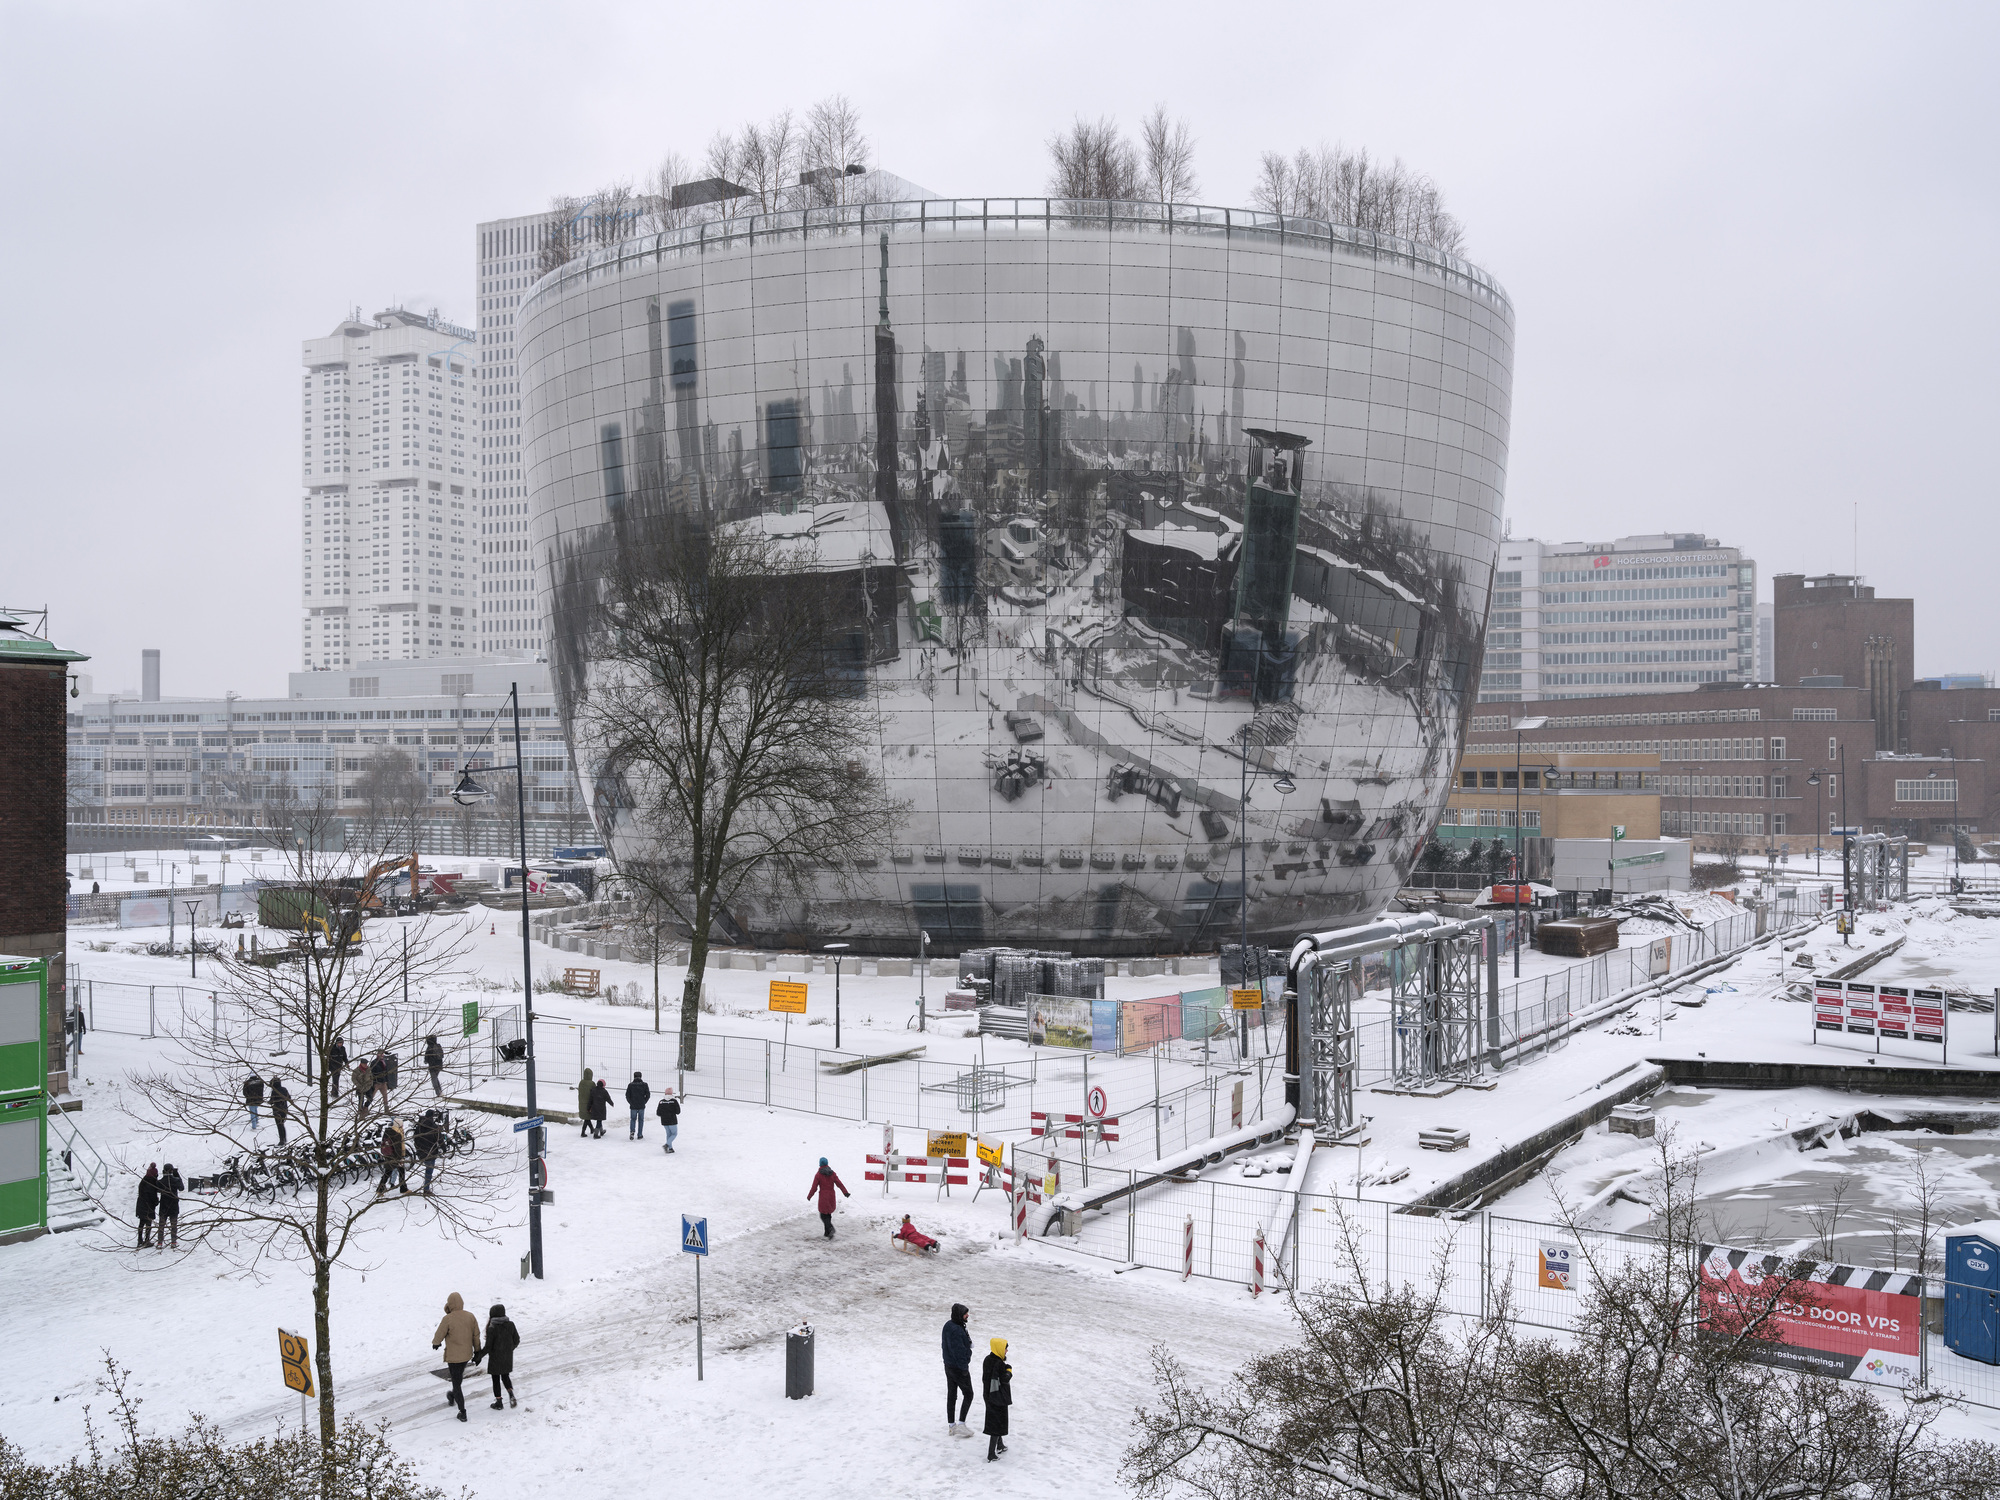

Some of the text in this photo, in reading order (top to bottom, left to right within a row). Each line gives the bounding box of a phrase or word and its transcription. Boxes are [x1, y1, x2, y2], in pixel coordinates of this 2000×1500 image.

[1617, 554, 1728, 565] HOGESCHOOL ROTTERDAM
[515, 1118, 543, 1130] Museumpark
[1810, 1306, 1861, 1326] DOOR
[1866, 1314, 1900, 1332] VPS
[1875, 1332, 1900, 1341] STRAFR.)
[1885, 1364, 1910, 1377] VPS
